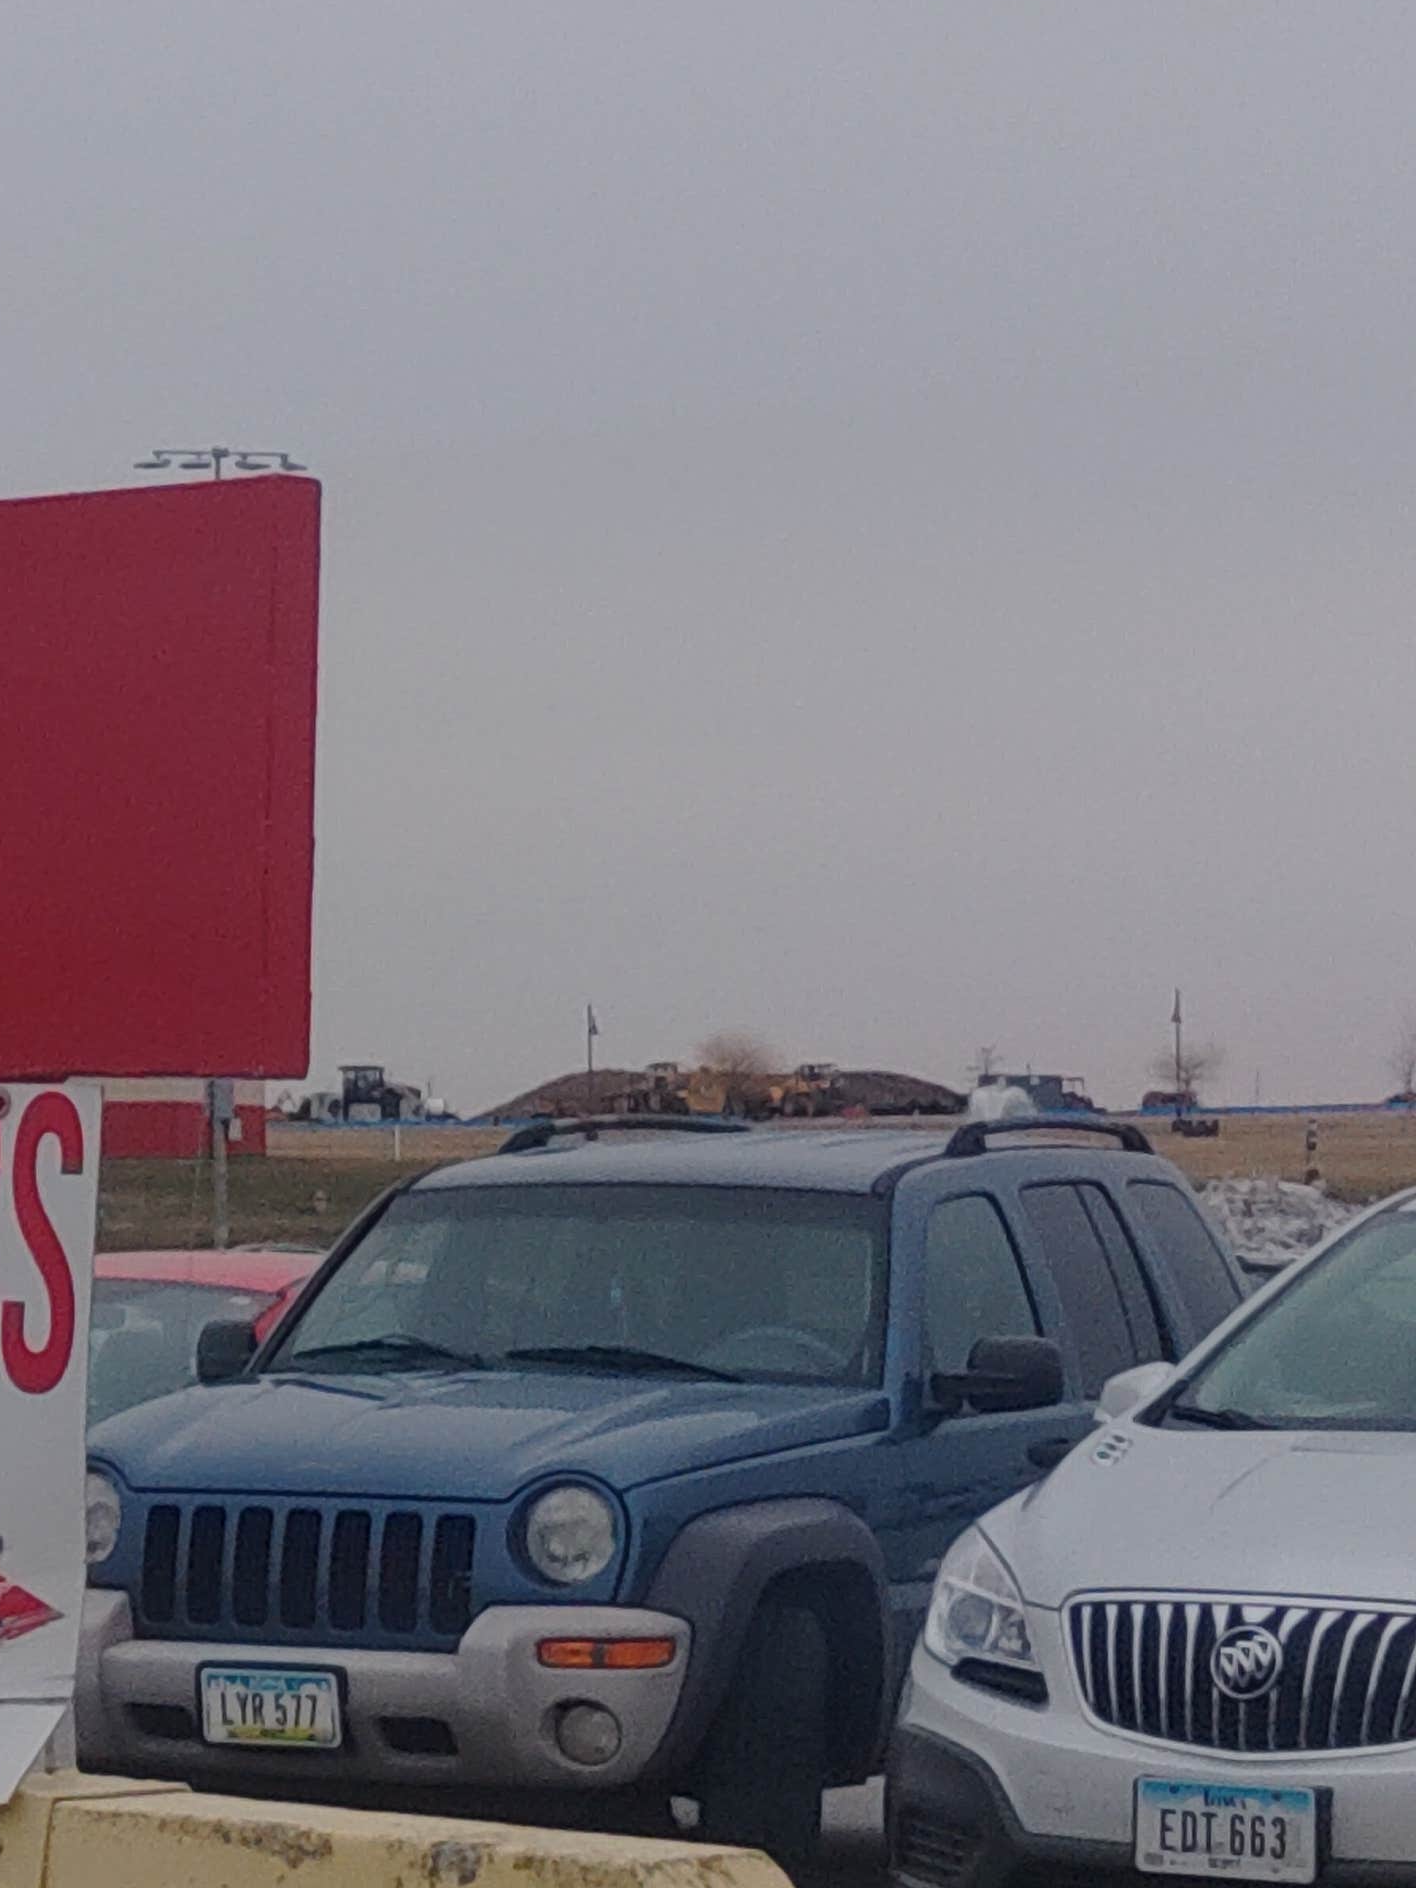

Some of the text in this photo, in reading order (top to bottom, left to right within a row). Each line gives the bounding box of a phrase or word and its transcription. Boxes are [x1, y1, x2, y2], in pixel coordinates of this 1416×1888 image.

[220, 1691, 317, 1728] LYR 577
[1159, 1808, 1286, 1859] EDT 663
